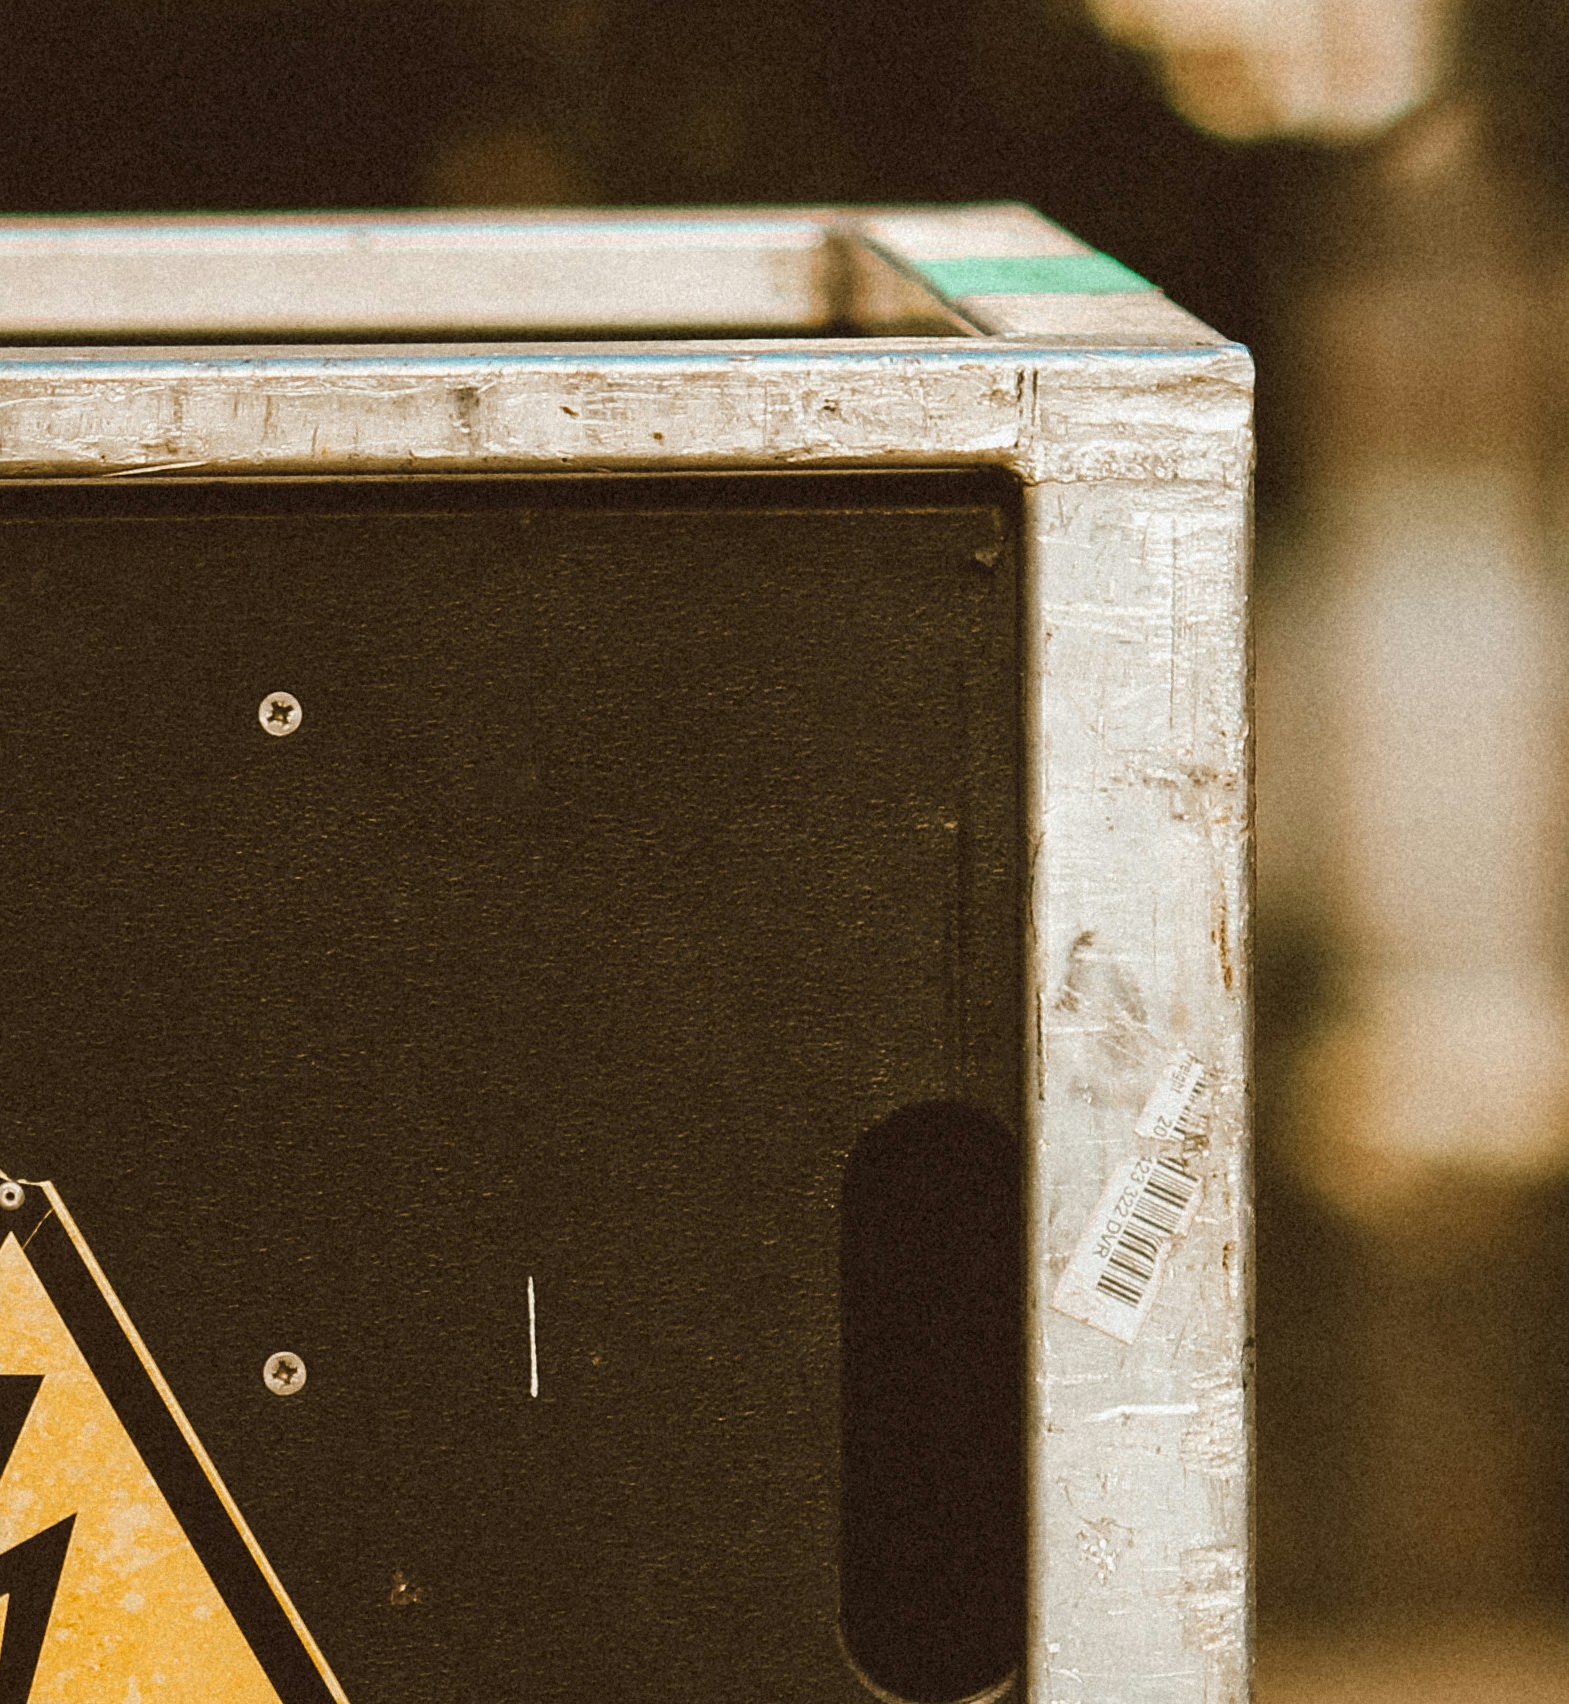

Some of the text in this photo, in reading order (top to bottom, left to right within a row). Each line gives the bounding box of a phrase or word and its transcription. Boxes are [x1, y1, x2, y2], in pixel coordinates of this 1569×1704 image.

[1153, 1115, 1172, 1137] 20
[1114, 1186, 1138, 1217] 322
[1093, 1220, 1122, 1258] DVR
